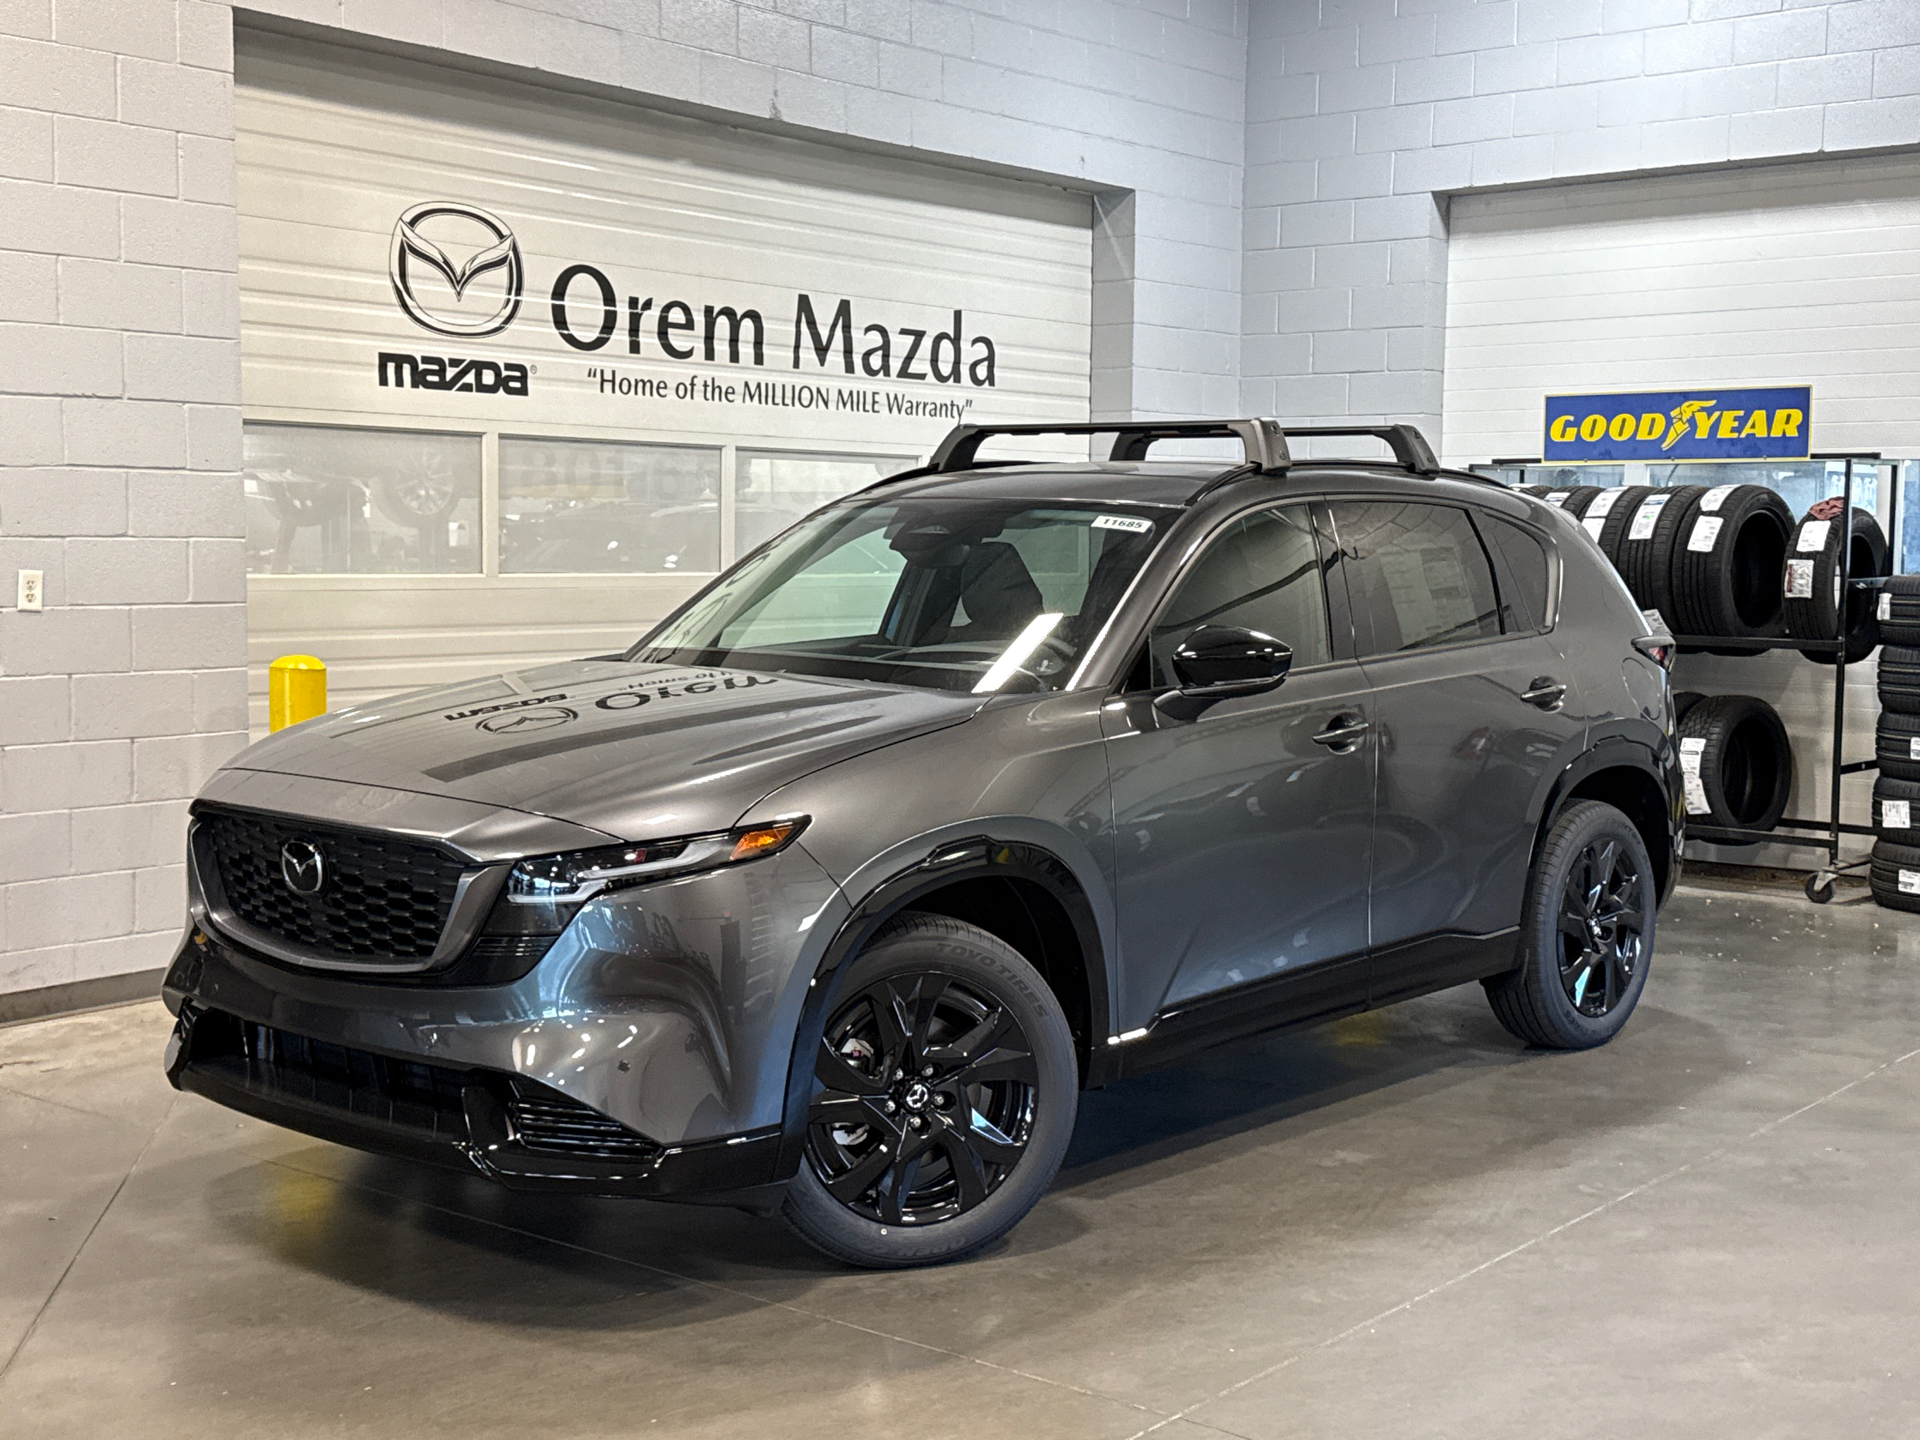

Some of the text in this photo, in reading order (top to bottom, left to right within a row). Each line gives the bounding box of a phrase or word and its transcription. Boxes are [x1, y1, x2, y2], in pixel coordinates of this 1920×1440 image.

[551, 264, 996, 388] Orem Mazda
[675, 375, 698, 400] of
[703, 377, 736, 403] the
[742, 381, 830, 410] MILLION
[836, 388, 880, 413] MILE
[1103, 518, 1143, 529] 11685
[937, 942, 1048, 1017] TOYO TIRES
